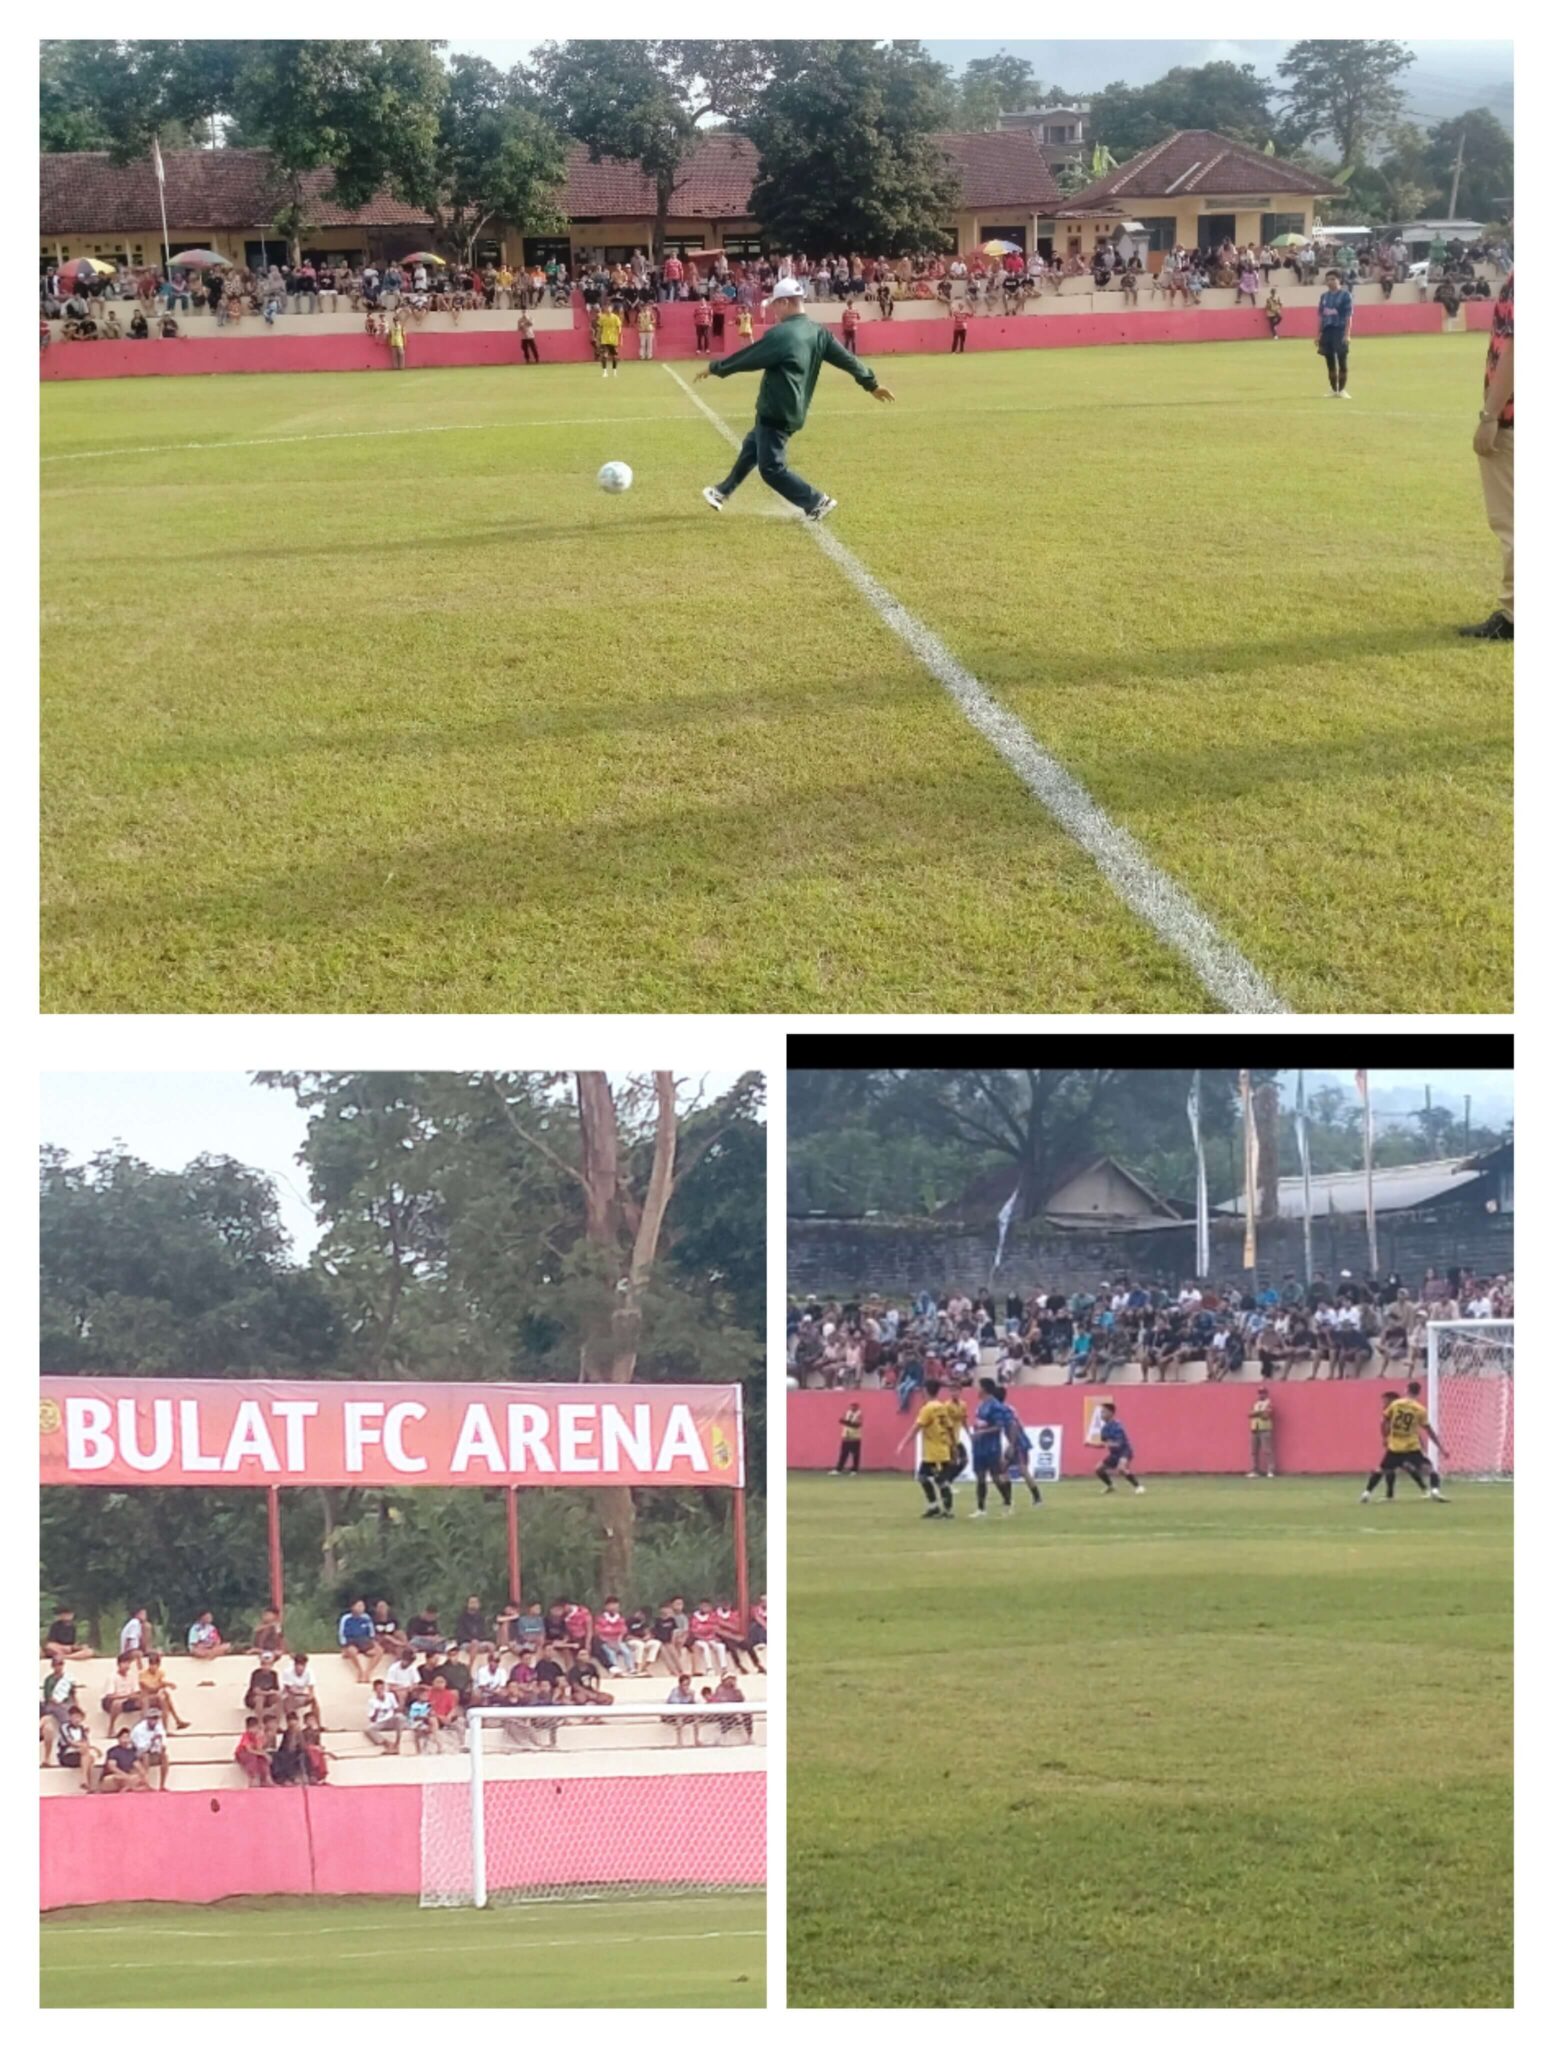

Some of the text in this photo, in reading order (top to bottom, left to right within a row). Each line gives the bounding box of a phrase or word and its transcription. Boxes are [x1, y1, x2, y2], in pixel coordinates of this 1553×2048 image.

[65, 1397, 710, 1473] BULAT FC ARENA
[1392, 1409, 1415, 1433] 29
